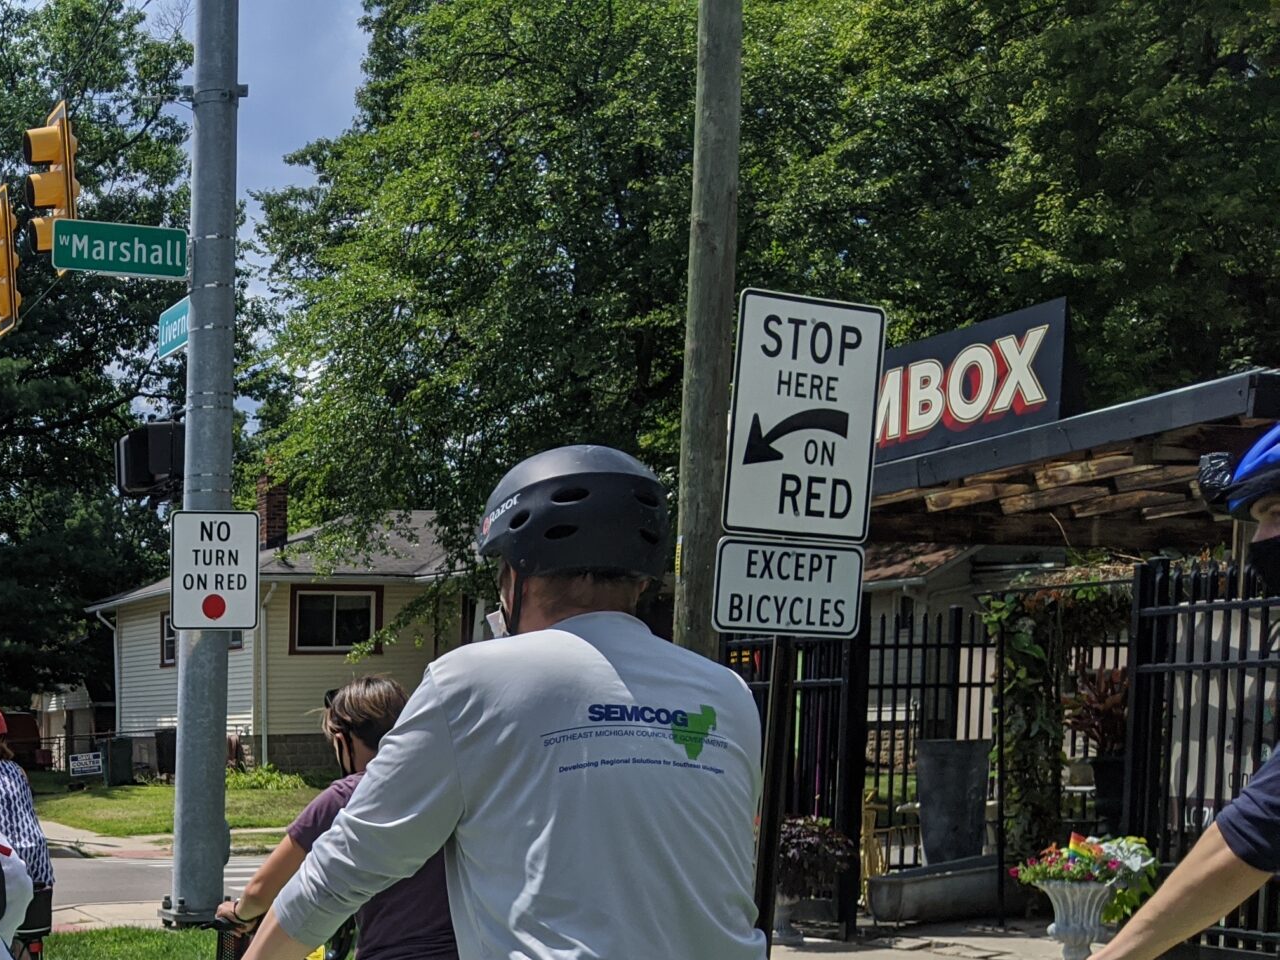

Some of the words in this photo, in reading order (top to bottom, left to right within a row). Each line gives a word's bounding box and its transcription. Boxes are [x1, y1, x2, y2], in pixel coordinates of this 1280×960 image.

[59, 234, 70, 246] W
[72, 233, 182, 267] Marshall
[760, 314, 862, 367] STOP
[777, 370, 839, 402] HERE
[804, 439, 835, 467] ON
[489, 493, 521, 526] Razor
[778, 473, 852, 519] RED
[200, 521, 231, 542] NO
[192, 549, 239, 566] TURN
[746, 549, 838, 584] EXCEPT
[183, 573, 207, 590] ON
[214, 574, 247, 590] RED
[728, 593, 845, 628] BICYCLES
[587, 703, 689, 728] SEMCOG
[543, 731, 593, 747] SOUTHEAST
[595, 729, 635, 737] MICHIGAN
[636, 730, 668, 739] COUNCIL
[558, 761, 599, 773] Developing
[600, 757, 631, 766] Regional
[632, 757, 662, 765] Solutions
